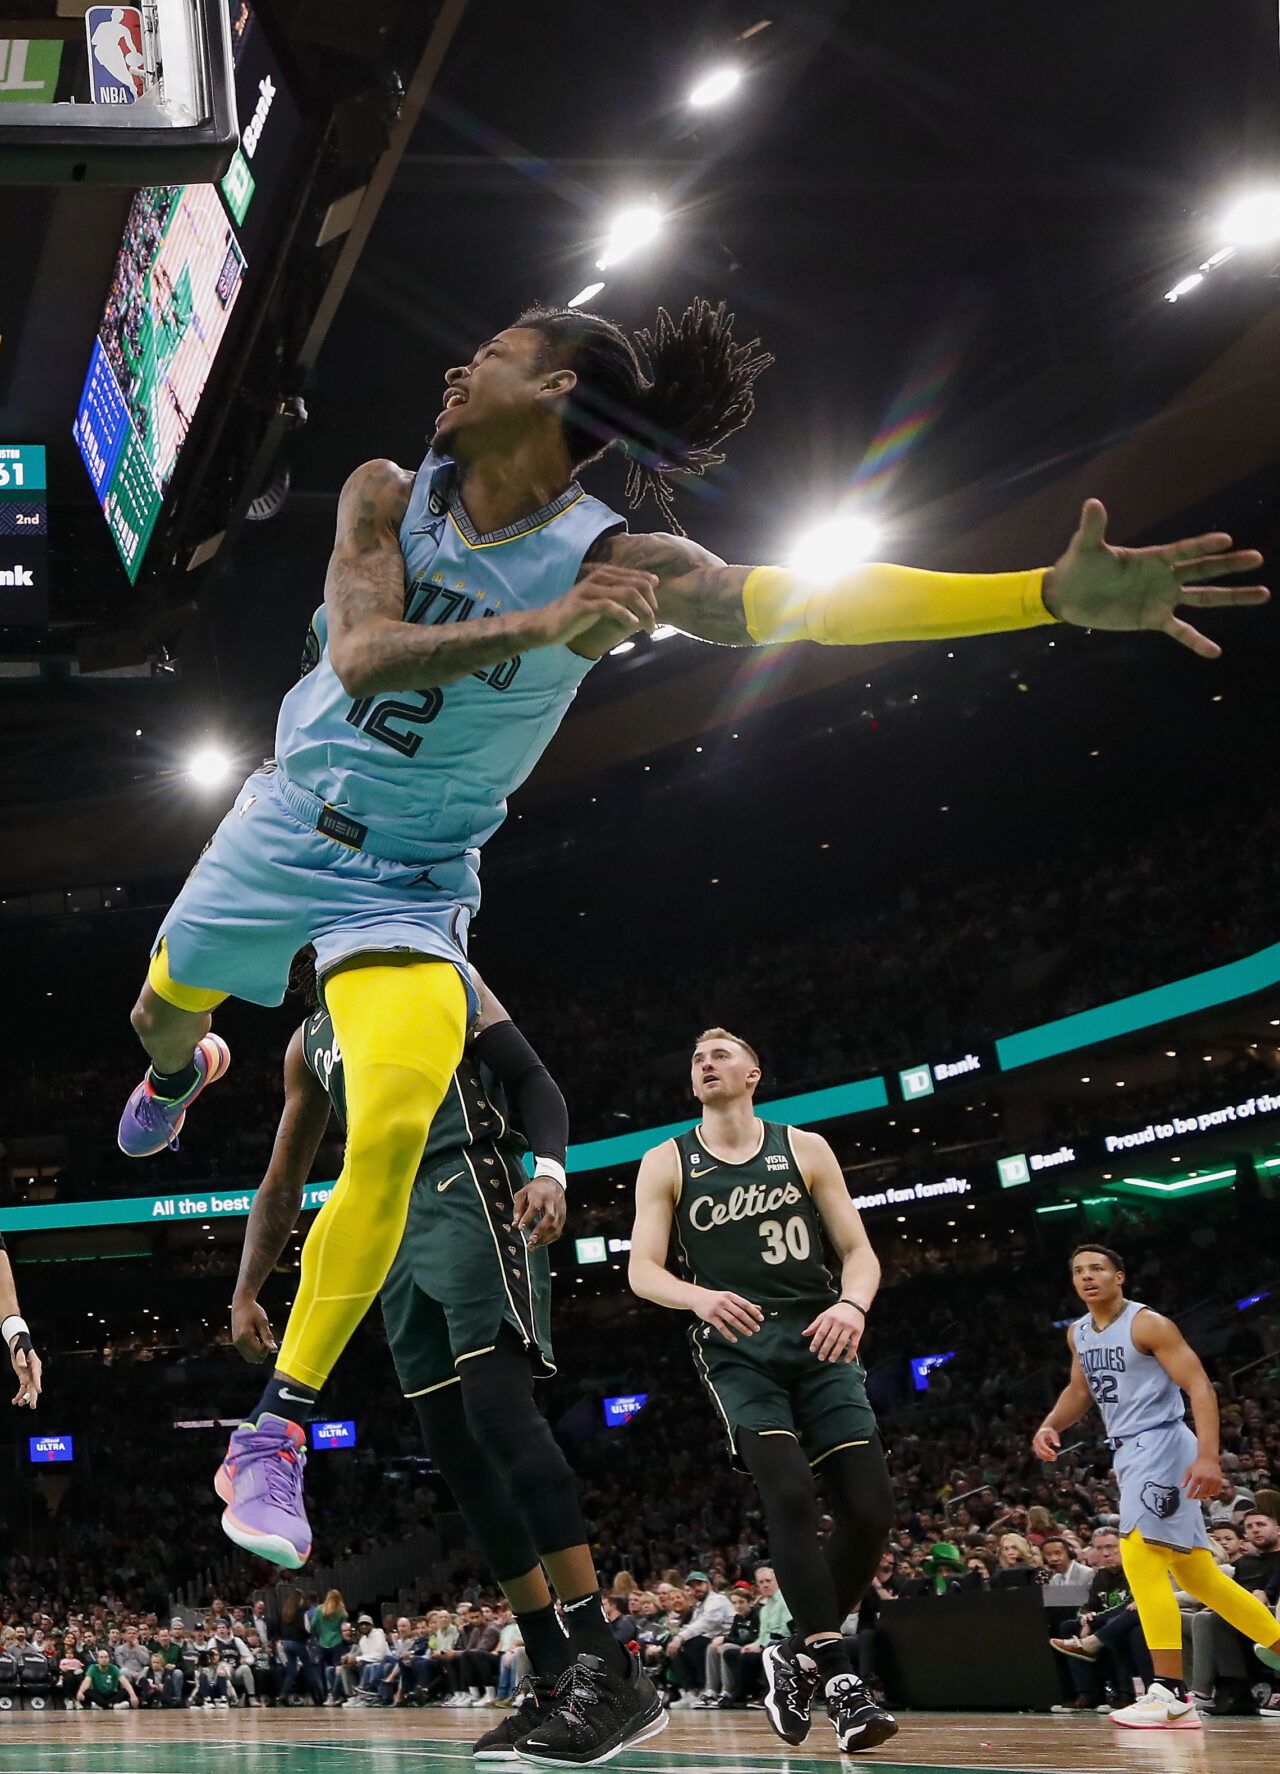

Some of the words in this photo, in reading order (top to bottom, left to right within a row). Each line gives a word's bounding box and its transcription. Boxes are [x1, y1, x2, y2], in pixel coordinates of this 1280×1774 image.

[100, 87, 127, 103] NBA
[242, 74, 276, 159] Bank
[428, 496, 441, 514] 6
[16, 513, 40, 525] 2nd
[934, 1055, 980, 1080] Bank
[1105, 1125, 1154, 1153] Proud
[1154, 1122, 1174, 1140] to
[1174, 1116, 1197, 1135] be
[1199, 1105, 1236, 1132] part
[1237, 1099, 1256, 1118] of
[690, 1153, 701, 1164] 6
[764, 1155, 788, 1164] VISTA
[766, 1163, 789, 1172] PRINT
[1030, 1147, 1075, 1170] Bank
[887, 1185, 915, 1205] fan
[915, 1176, 971, 1201] family.
[153, 1200, 174, 1216] All
[179, 1199, 207, 1214] the
[212, 1197, 250, 1211] best
[689, 1182, 802, 1232] Celtics
[758, 1215, 810, 1265] 30
[1088, 1375, 1119, 1404] 22
[318, 1429, 348, 1438] ULTRA
[36, 1442, 66, 1451] ULTRA
